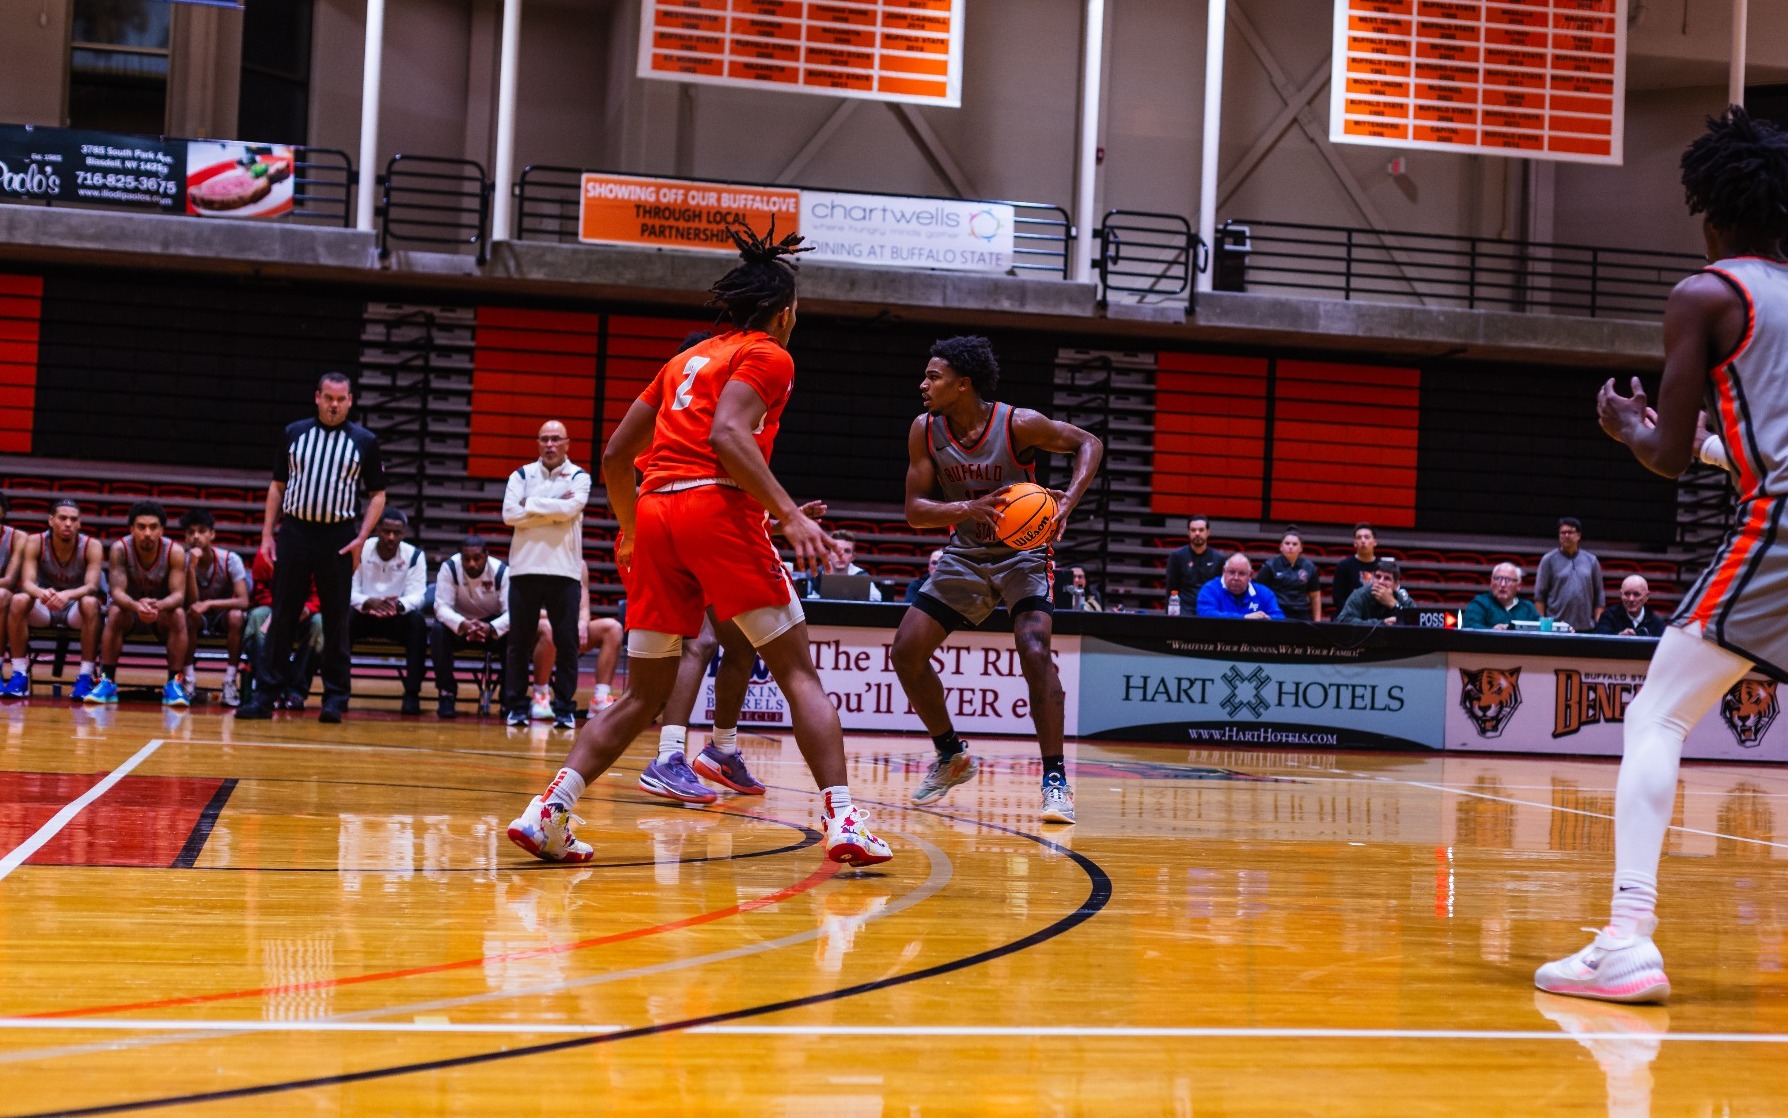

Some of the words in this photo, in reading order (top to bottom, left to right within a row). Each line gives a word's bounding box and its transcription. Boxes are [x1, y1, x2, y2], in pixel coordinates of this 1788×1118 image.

[107, 146, 132, 158] South
[134, 149, 155, 160] Park
[124, 160, 138, 169] NY
[75, 171, 177, 195] 716-825-3675
[586, 182, 657, 201] SHOWING
[658, 188, 685, 204] OFF
[688, 190, 718, 206] OUR
[720, 192, 797, 212] BUFFALOVE
[634, 204, 702, 222] THROUGH
[706, 210, 748, 226] LOCAL
[811, 200, 960, 228] chartwells
[640, 223, 741, 243] PARTNERSHIP
[809, 240, 862, 258] DINING
[867, 244, 886, 258] AT
[890, 246, 956, 262] BUFFALO
[961, 250, 1002, 266] STATE
[671, 356, 710, 410] 2
[944, 464, 1002, 482] BUFFALO
[976, 522, 996, 542] STA
[1011, 515, 1050, 546] Wilson
[1419, 613, 1444, 627] POSS
[809, 640, 870, 672] The
[880, 644, 970, 675] ST
[1584, 672, 1626, 680] BUFFALO
[1630, 674, 1647, 682] STA
[706, 684, 777, 697] SKIN
[827, 682, 894, 714] ou'll
[1122, 674, 1214, 704] HART
[1276, 682, 1405, 712] HOTELS
[707, 697, 784, 710] BRELS
